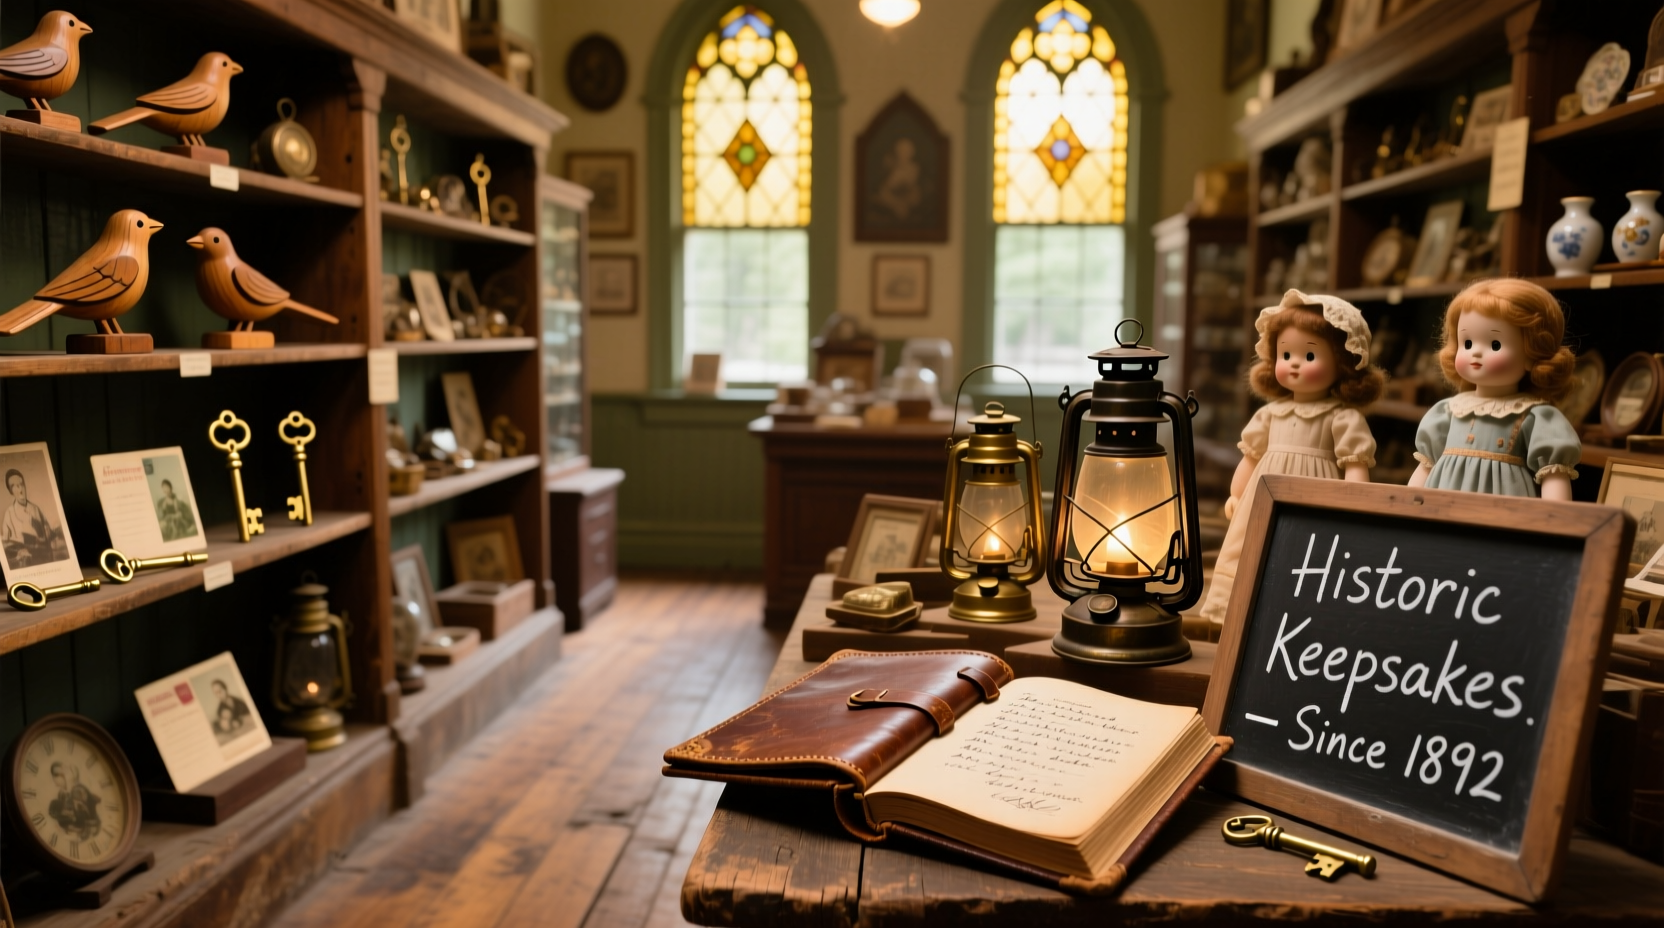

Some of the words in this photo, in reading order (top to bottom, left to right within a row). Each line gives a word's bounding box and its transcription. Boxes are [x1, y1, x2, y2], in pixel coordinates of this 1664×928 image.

[1291, 532, 1502, 625] Historic
[1265, 612, 1535, 727] Keepsakes.
[1287, 704, 1387, 769] Since
[1403, 734, 1504, 802] 1892
